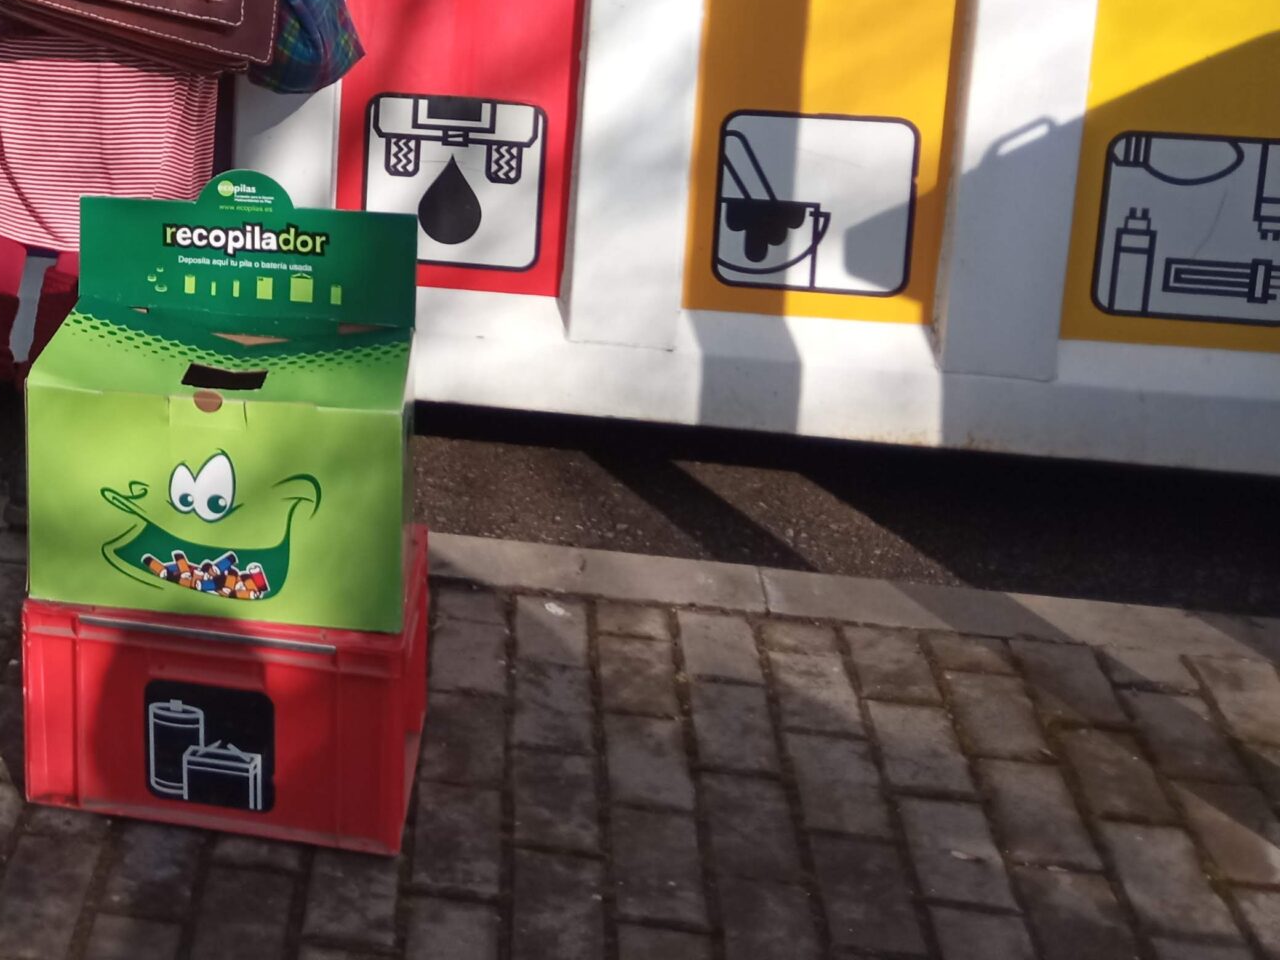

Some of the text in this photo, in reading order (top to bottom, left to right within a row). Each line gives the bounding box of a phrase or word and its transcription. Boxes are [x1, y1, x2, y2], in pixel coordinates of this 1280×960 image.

[165, 224, 327, 256] recopilador
[178, 255, 211, 265] Deposita
[239, 260, 252, 268] pila
